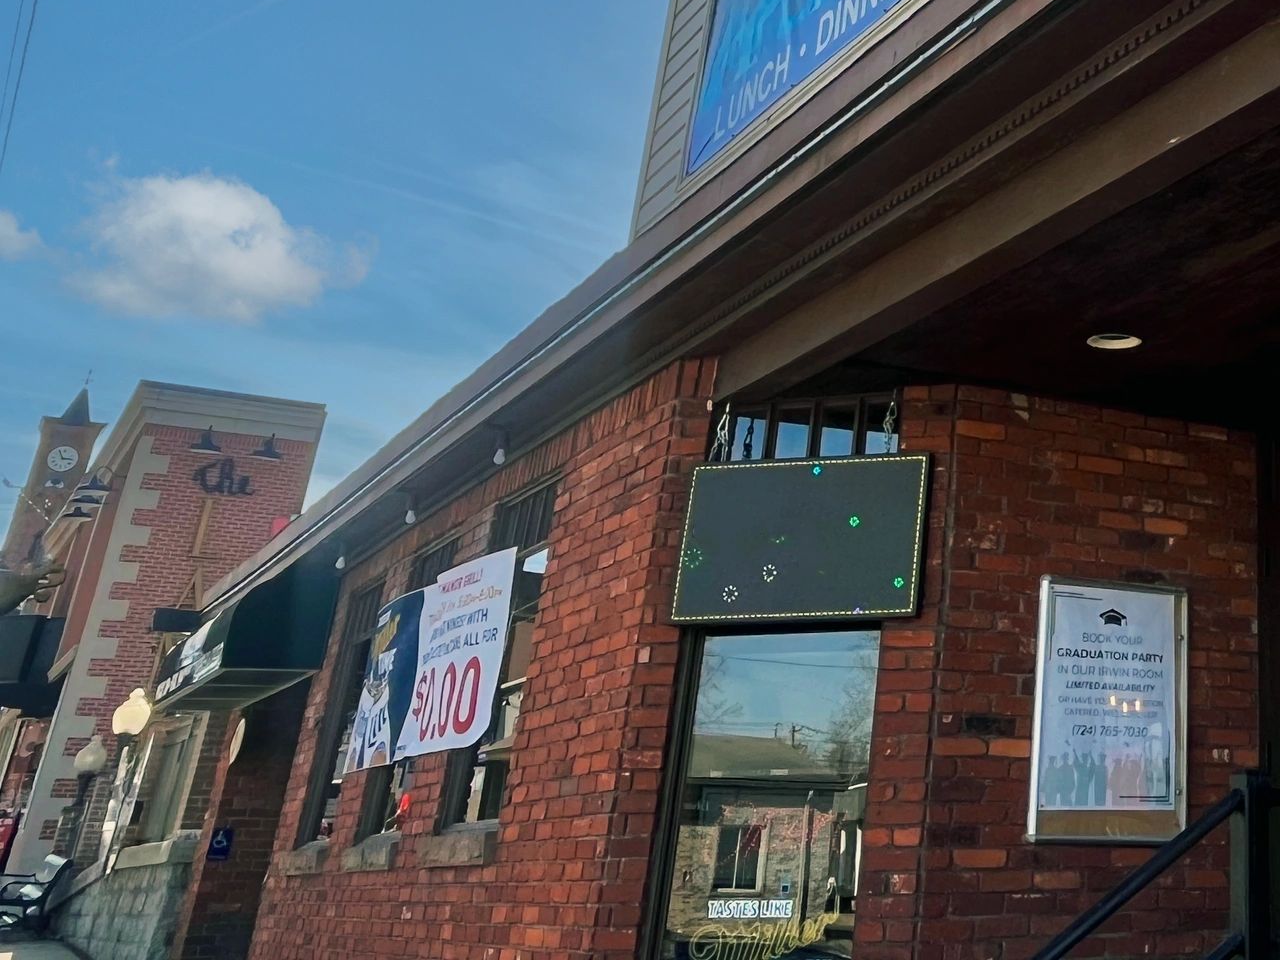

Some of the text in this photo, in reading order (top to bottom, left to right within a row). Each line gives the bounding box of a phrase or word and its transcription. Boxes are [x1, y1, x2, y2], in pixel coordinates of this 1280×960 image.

[712, 43, 791, 142] LUNCH
[462, 632, 480, 647] ALL
[1082, 631, 1144, 646] BOOK YOUR
[1056, 647, 1164, 664] GRADUATION PARTY
[1057, 664, 1164, 680] IN OUR IRWIN ROOM
[1065, 680, 1156, 694] LIMITED AVAILABILITY
[1072, 724, 1097, 737] (724)
[707, 899, 793, 919] TASTES LIKE
